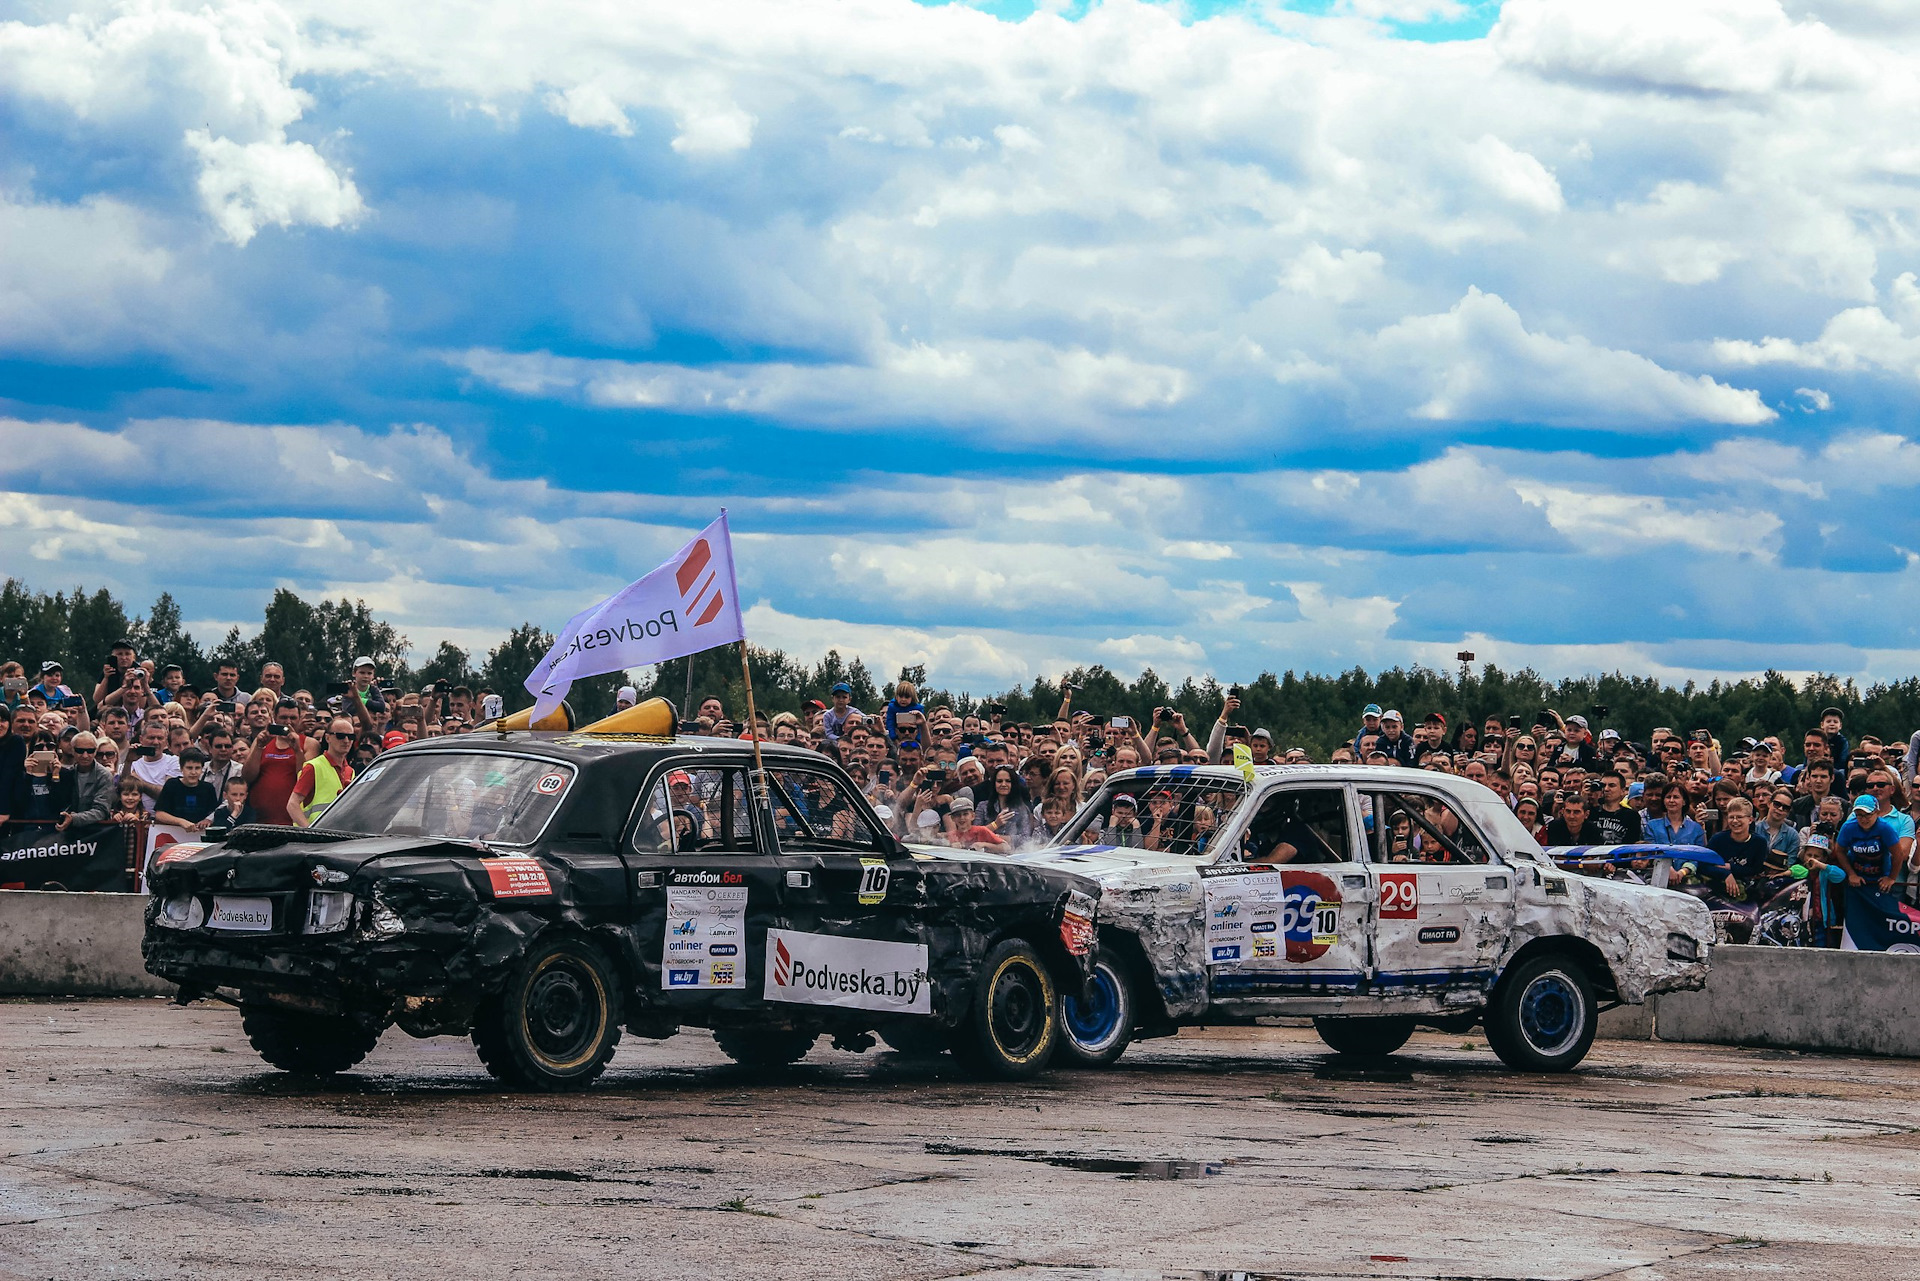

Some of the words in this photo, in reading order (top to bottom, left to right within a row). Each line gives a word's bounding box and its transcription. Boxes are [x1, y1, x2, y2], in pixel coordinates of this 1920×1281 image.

[542, 778, 560, 789] 69
[1, 840, 97, 860] arenaderby
[865, 867, 888, 892] 16
[1380, 881, 1417, 911] 29
[218, 911, 268, 925] Podveska.by
[1316, 910, 1336, 934] 10
[1211, 920, 1243, 931] onliner
[1421, 931, 1445, 939] ПИЛОТ
[1446, 931, 1456, 939] FM
[669, 940, 703, 951] onliner
[1254, 945, 1275, 957] 7535
[673, 972, 694, 983] av.by
[791, 961, 919, 1005] Podveska.by
